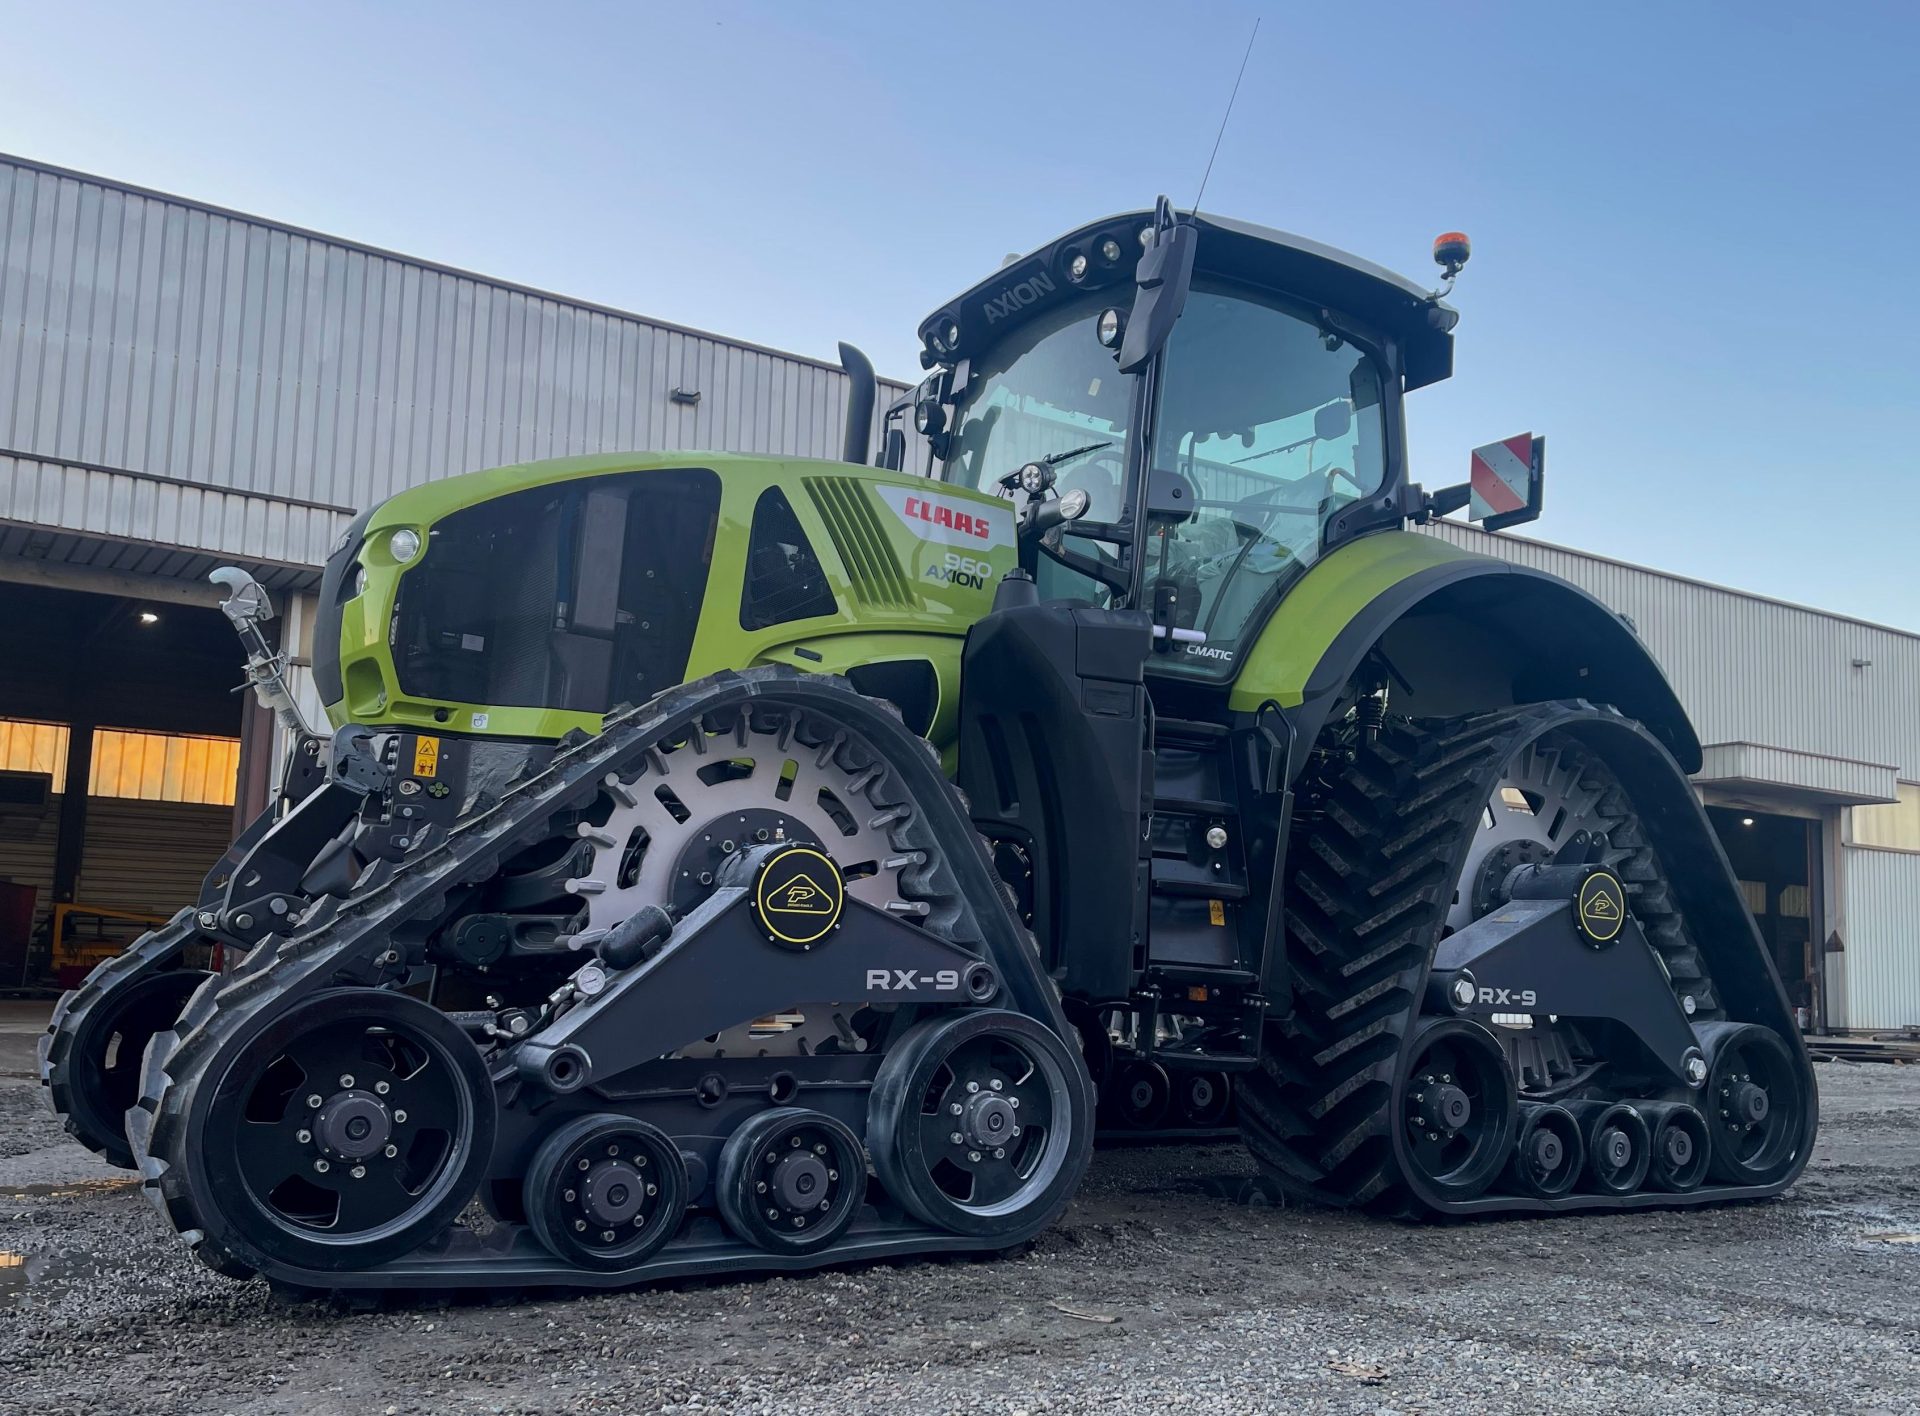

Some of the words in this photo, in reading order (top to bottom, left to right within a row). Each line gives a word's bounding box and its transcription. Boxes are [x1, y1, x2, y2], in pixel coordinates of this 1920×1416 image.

[983, 271, 1057, 325] AXION
[904, 497, 990, 540] CLAAS
[925, 565, 984, 591] AXION
[944, 552, 993, 578] 960
[1186, 645, 1234, 661] CMATIC
[866, 969, 959, 990] RX-9
[1478, 987, 1537, 1007] RX-9
